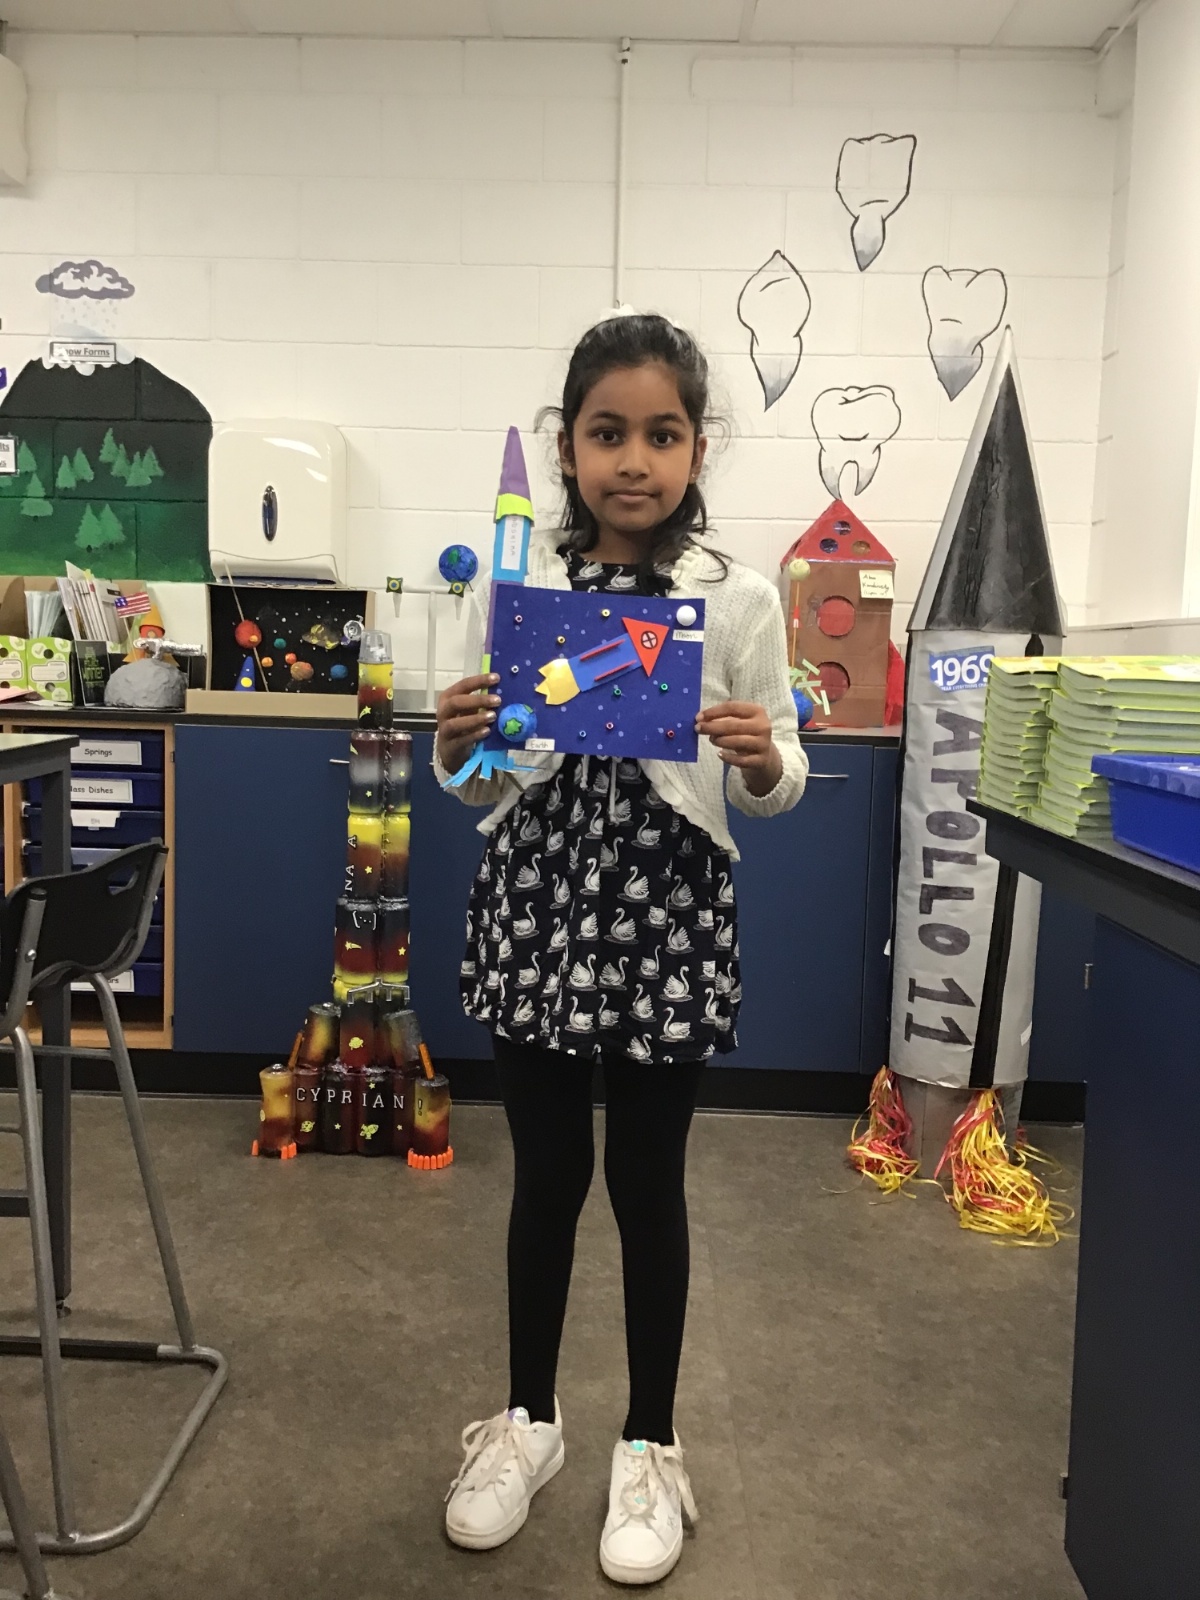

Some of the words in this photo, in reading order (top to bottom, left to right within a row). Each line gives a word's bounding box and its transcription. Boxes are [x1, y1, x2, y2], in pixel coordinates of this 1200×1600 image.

[84, 347, 110, 356] Forms
[931, 653, 994, 687] 1969
[84, 748, 113, 758] Springs
[71, 785, 86, 793] lass
[88, 785, 114, 794] Dishes
[918, 708, 986, 957] APOLLO
[904, 977, 977, 1048] 11
